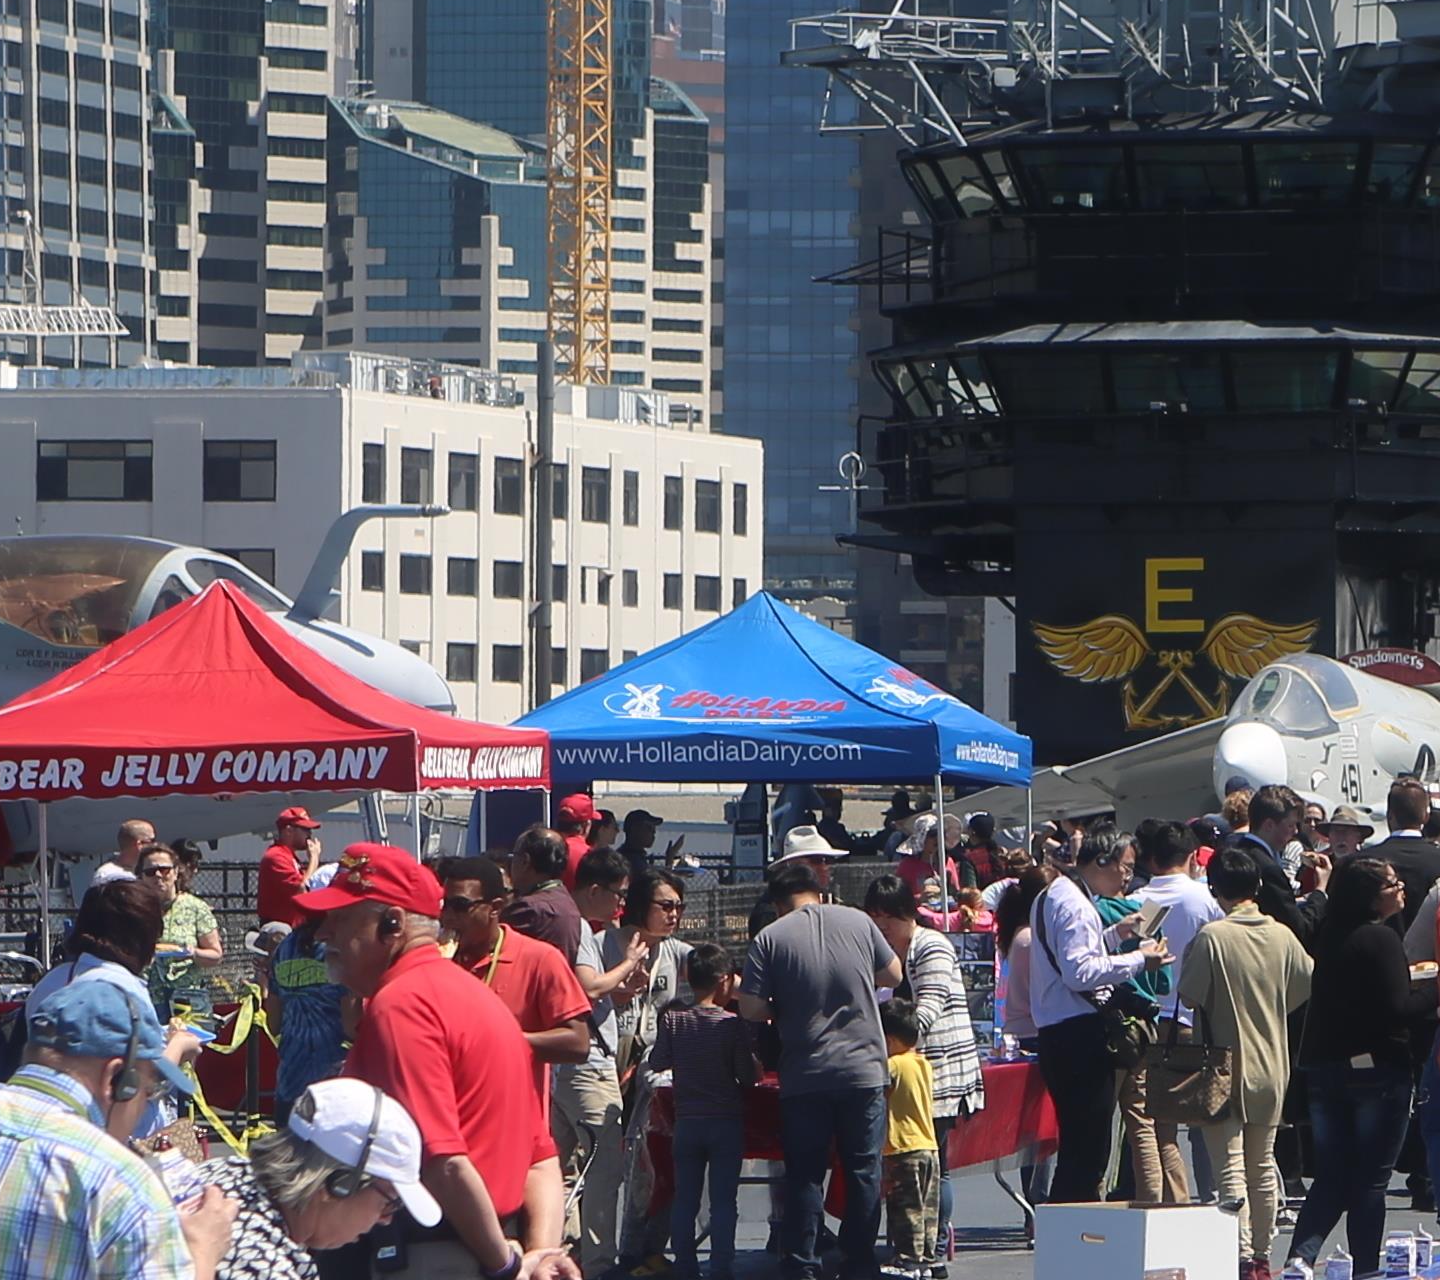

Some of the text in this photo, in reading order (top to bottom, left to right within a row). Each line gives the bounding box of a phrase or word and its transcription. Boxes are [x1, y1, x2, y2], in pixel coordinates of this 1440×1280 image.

[1145, 557, 1205, 632] E
[1348, 648, 1424, 670] Sundowners
[670, 689, 847, 712] HOLLANDIA
[100, 752, 205, 788] JELLY
[211, 745, 388, 785] COMPANY
[422, 746, 544, 780] JELLYBEAR JELLY COMPANY
[556, 739, 862, 767] www.HollandiaDairy.com
[956, 740, 1019, 772] www.HollandiaDairy.com
[1340, 763, 1362, 804] 461
